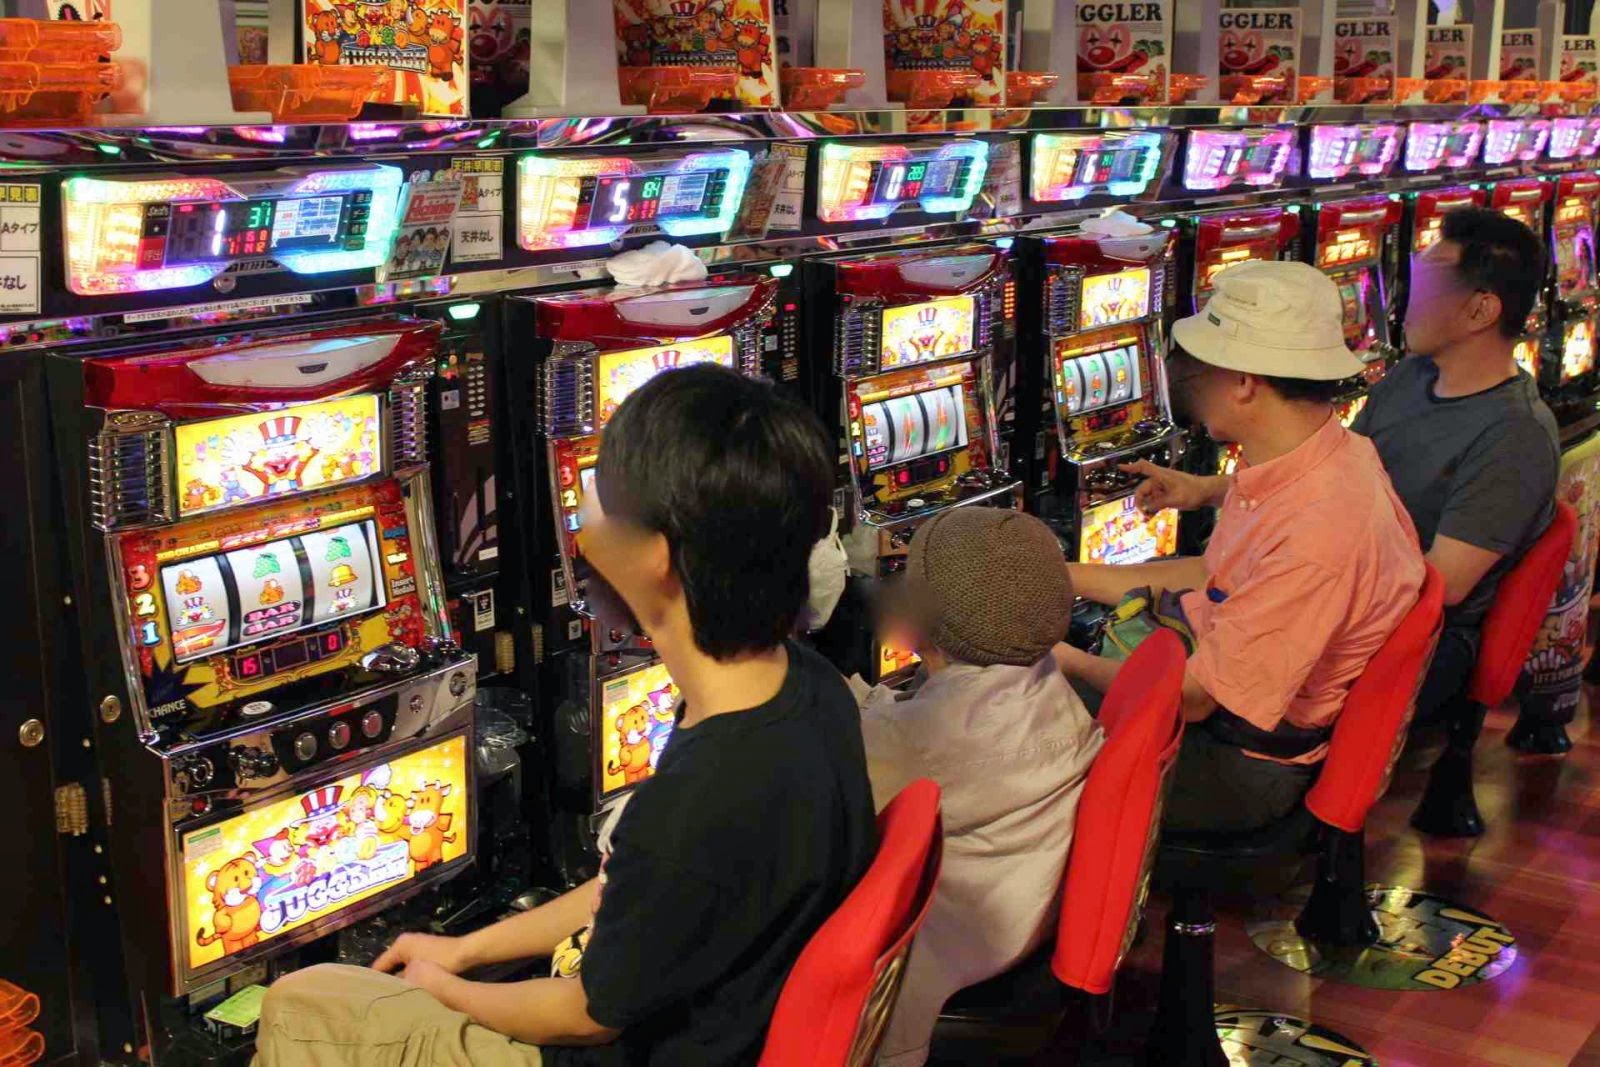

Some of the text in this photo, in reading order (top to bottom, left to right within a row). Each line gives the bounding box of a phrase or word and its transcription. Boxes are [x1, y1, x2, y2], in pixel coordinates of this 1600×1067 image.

[1075, 3, 1163, 22] GGLER
[1219, 13, 1293, 30] GGLER
[1335, 21, 1390, 37] GLER
[1428, 28, 1464, 43] LER
[609, 182, 630, 222] 5
[248, 206, 271, 228] 31
[460, 231, 493, 243] 天井なし
[562, 490, 577, 507] 2
[566, 513, 580, 532] 1
[131, 565, 151, 590] 3
[136, 594, 157, 618] 2
[142, 622, 161, 646] 1
[149, 700, 187, 718] CHANCE
